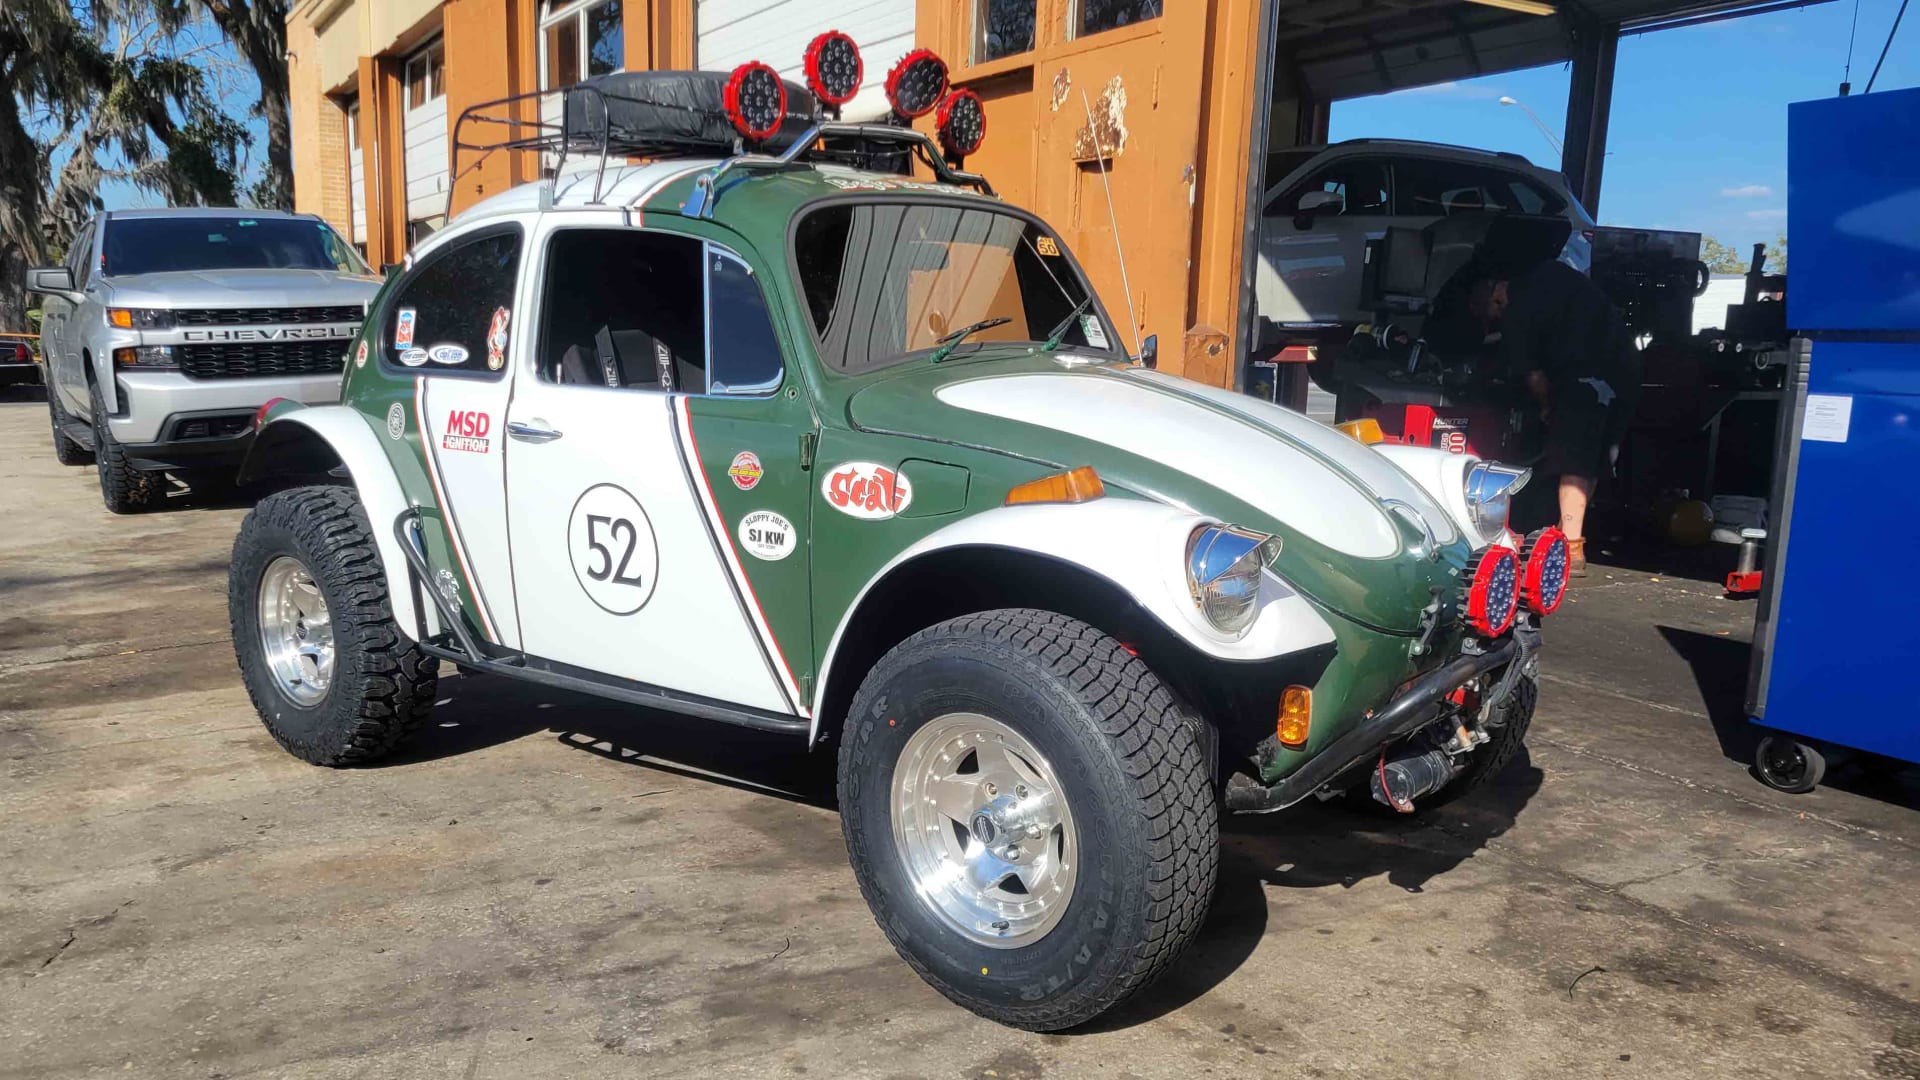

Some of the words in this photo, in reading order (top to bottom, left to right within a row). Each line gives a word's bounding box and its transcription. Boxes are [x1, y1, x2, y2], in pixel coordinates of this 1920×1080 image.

[183, 327, 362, 341] CHEVROLE
[447, 410, 490, 437] MSD
[1433, 417, 1469, 425] HUNTER
[445, 435, 489, 453] IGNITION
[745, 514, 770, 527] SLOPPY
[771, 515, 789, 531] JOE'S
[749, 528, 762, 543] SJ
[765, 530, 785, 546] KW
[586, 513, 642, 588] 52
[1002, 680, 1114, 930] PATAGONIA
